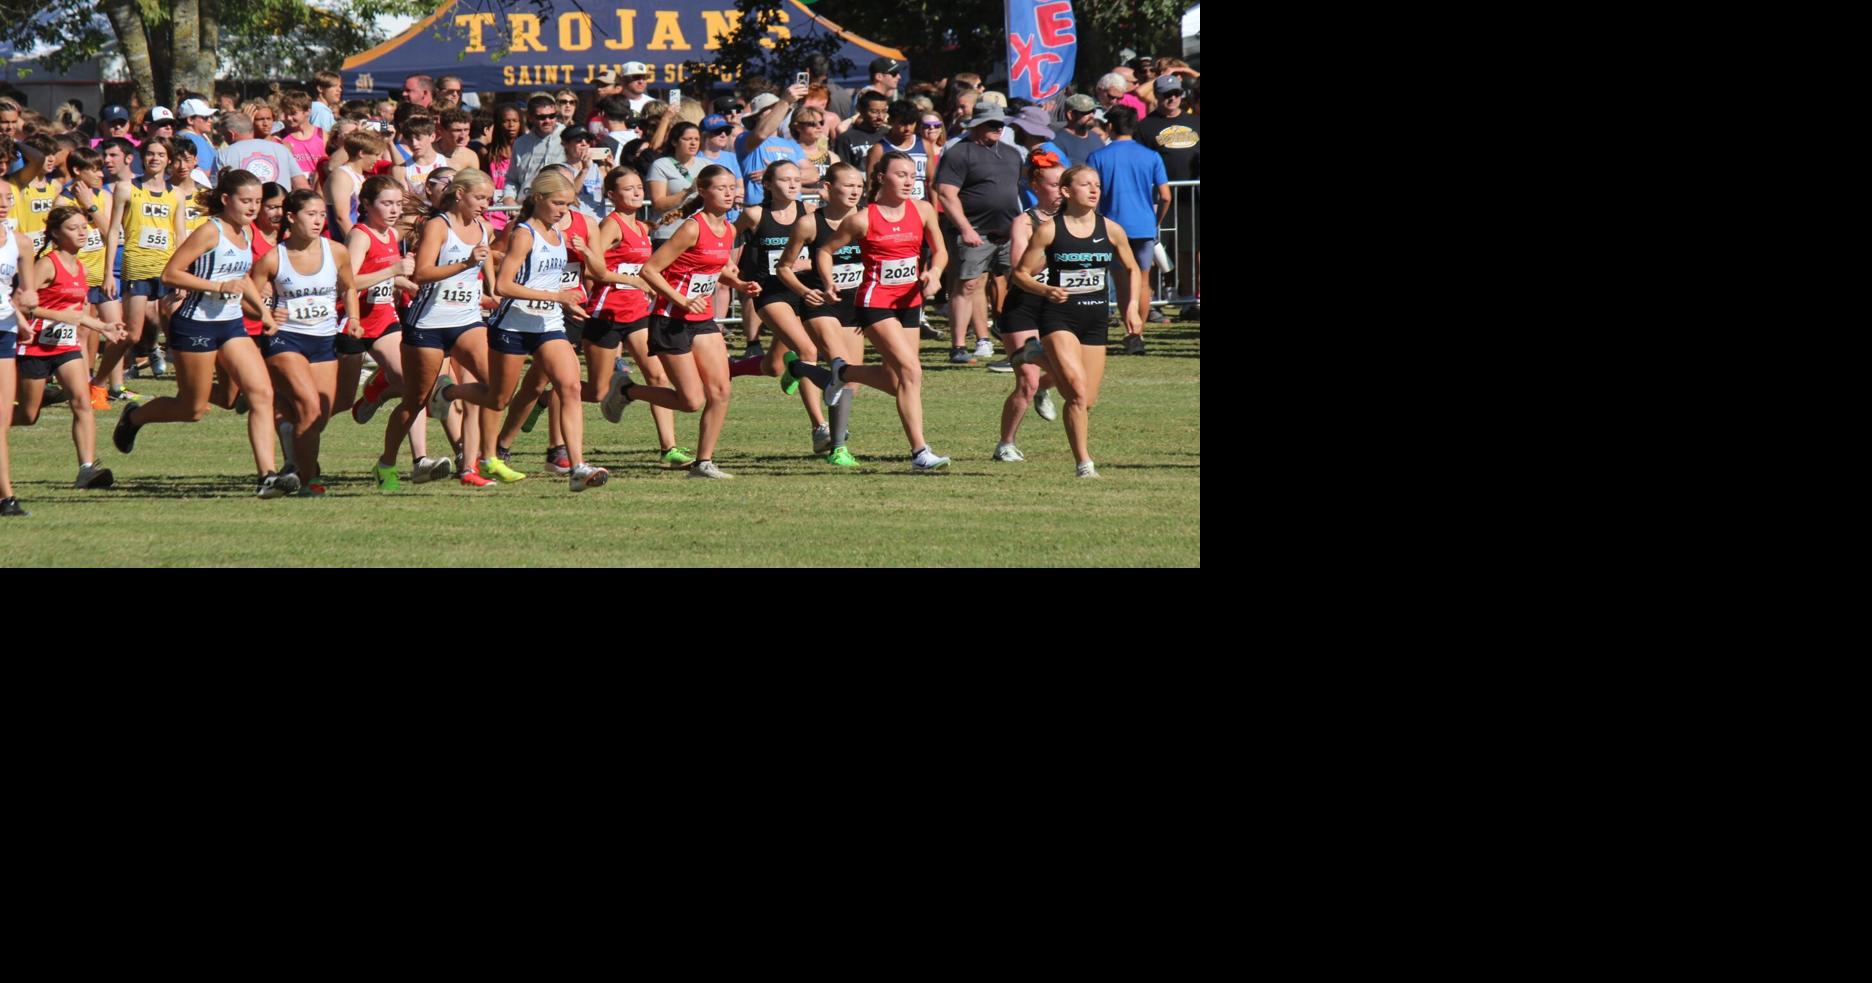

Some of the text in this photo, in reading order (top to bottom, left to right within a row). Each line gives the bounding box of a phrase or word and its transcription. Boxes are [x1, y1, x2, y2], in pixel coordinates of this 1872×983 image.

[455, 8, 792, 52] TROJANS
[503, 64, 574, 86] SAINT
[142, 202, 170, 217] CCS
[147, 234, 168, 246] 555
[1055, 252, 1112, 262] NORTH
[832, 270, 863, 283] 2727
[884, 265, 916, 279] 2020
[1066, 275, 1100, 288] 2718
[442, 289, 473, 303] 1155
[294, 306, 329, 319] 1152
[44, 327, 73, 340] 2032
